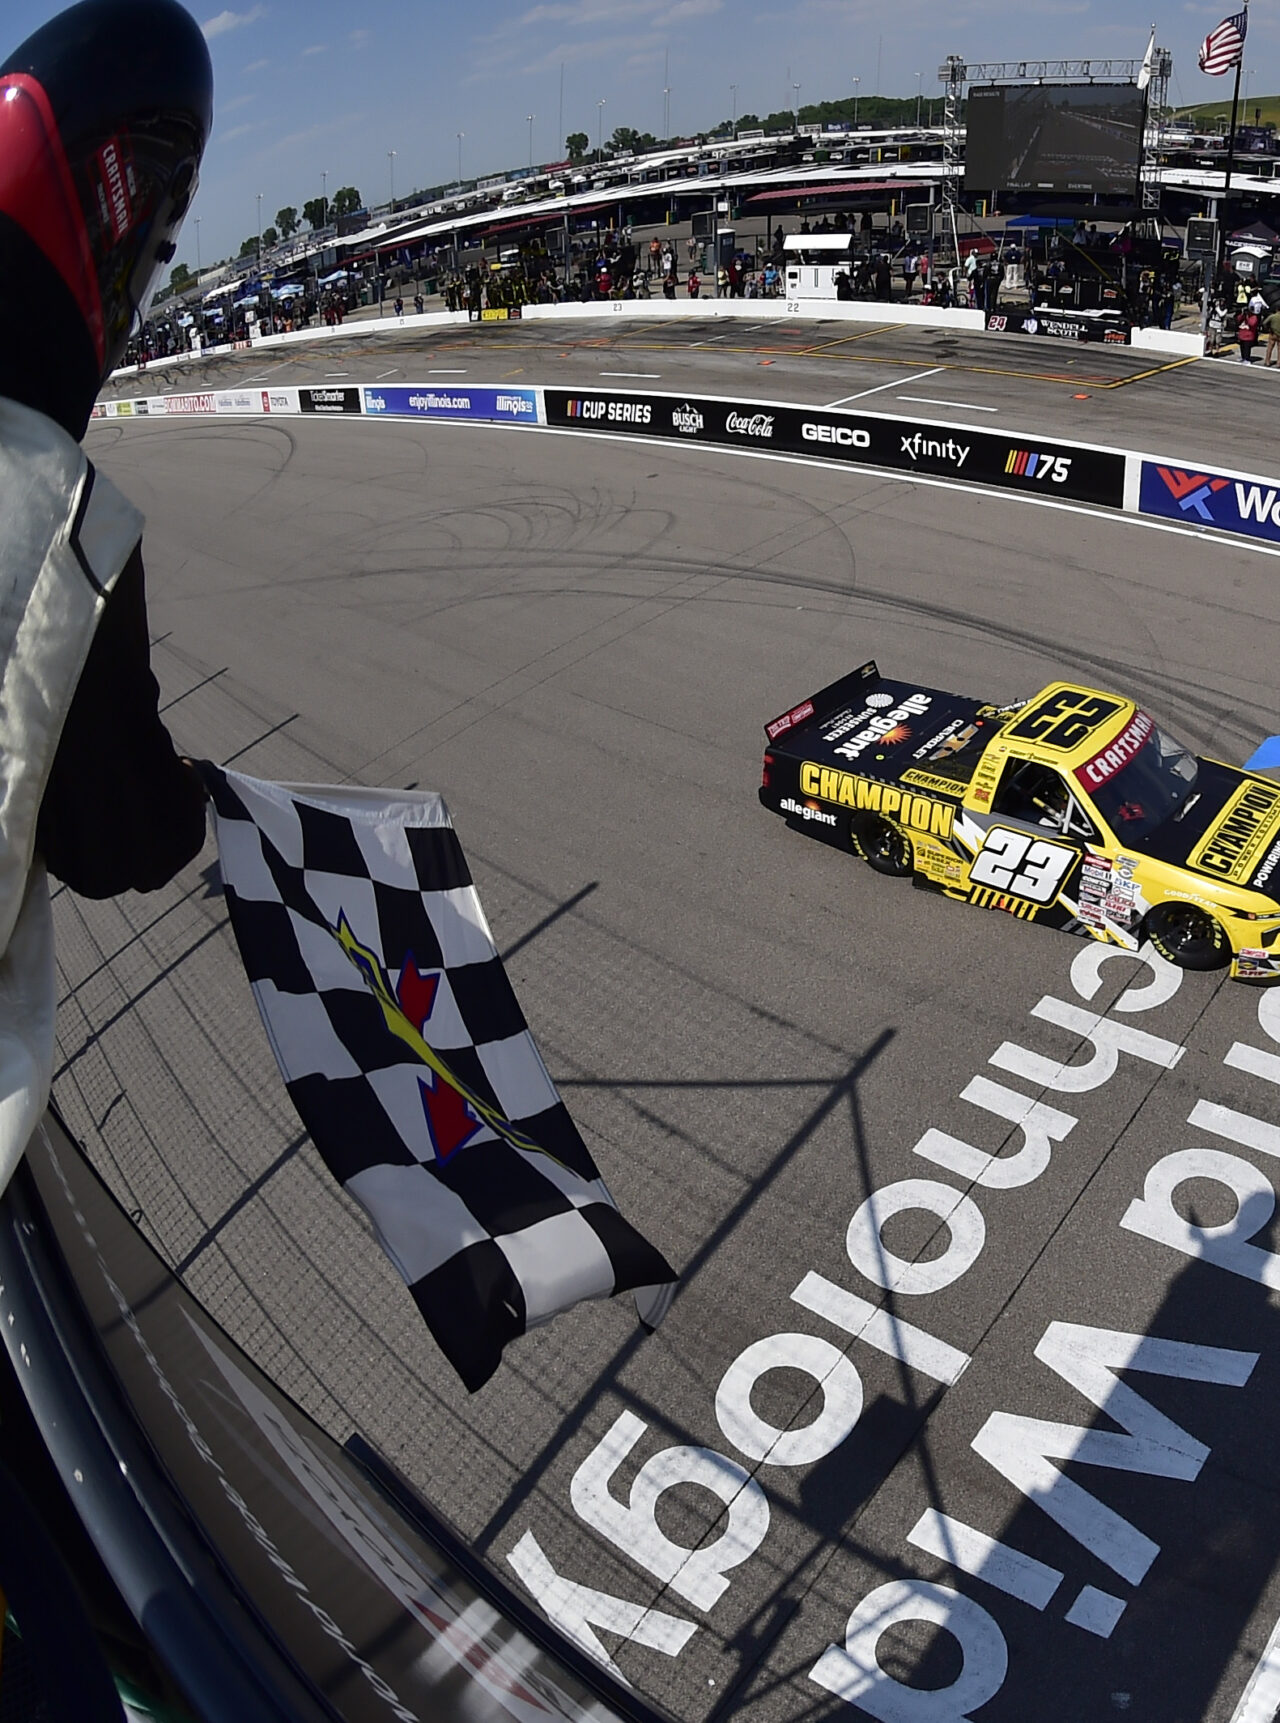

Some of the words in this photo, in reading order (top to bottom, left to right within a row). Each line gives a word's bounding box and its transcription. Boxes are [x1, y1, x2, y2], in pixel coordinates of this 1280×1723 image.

[103, 144, 129, 235] CRAFTSMAN
[613, 303, 623, 312] 23
[787, 303, 800, 312] 22
[1040, 319, 1089, 332] WENDELL
[1047, 326, 1080, 339] SCOTT
[583, 400, 605, 420] CUP
[608, 403, 652, 424] SERIES
[672, 411, 704, 429] BUSCH
[679, 425, 697, 434] LIGHT
[801, 423, 870, 448] GEICO
[900, 432, 970, 467] xfinity
[1036, 454, 1072, 483] 75
[822, 707, 877, 742] SUNSEEKER
[834, 693, 932, 761] allegiant
[1008, 690, 1122, 749] 23
[912, 719, 964, 760] CHEVROLET
[1085, 711, 1153, 784] CRAFTSMAN
[905, 770, 968, 793] CHAMPION
[780, 799, 838, 827] allegiant
[802, 763, 953, 839] CHAMPION
[1199, 786, 1279, 874] CHAMPION
[969, 827, 1075, 902] 23
[1233, 843, 1256, 877] POWER
[1164, 889, 1217, 908] GOODYEAR
[505, 939, 1187, 1688] chnology
[808, 1321, 1261, 1723] Wid
